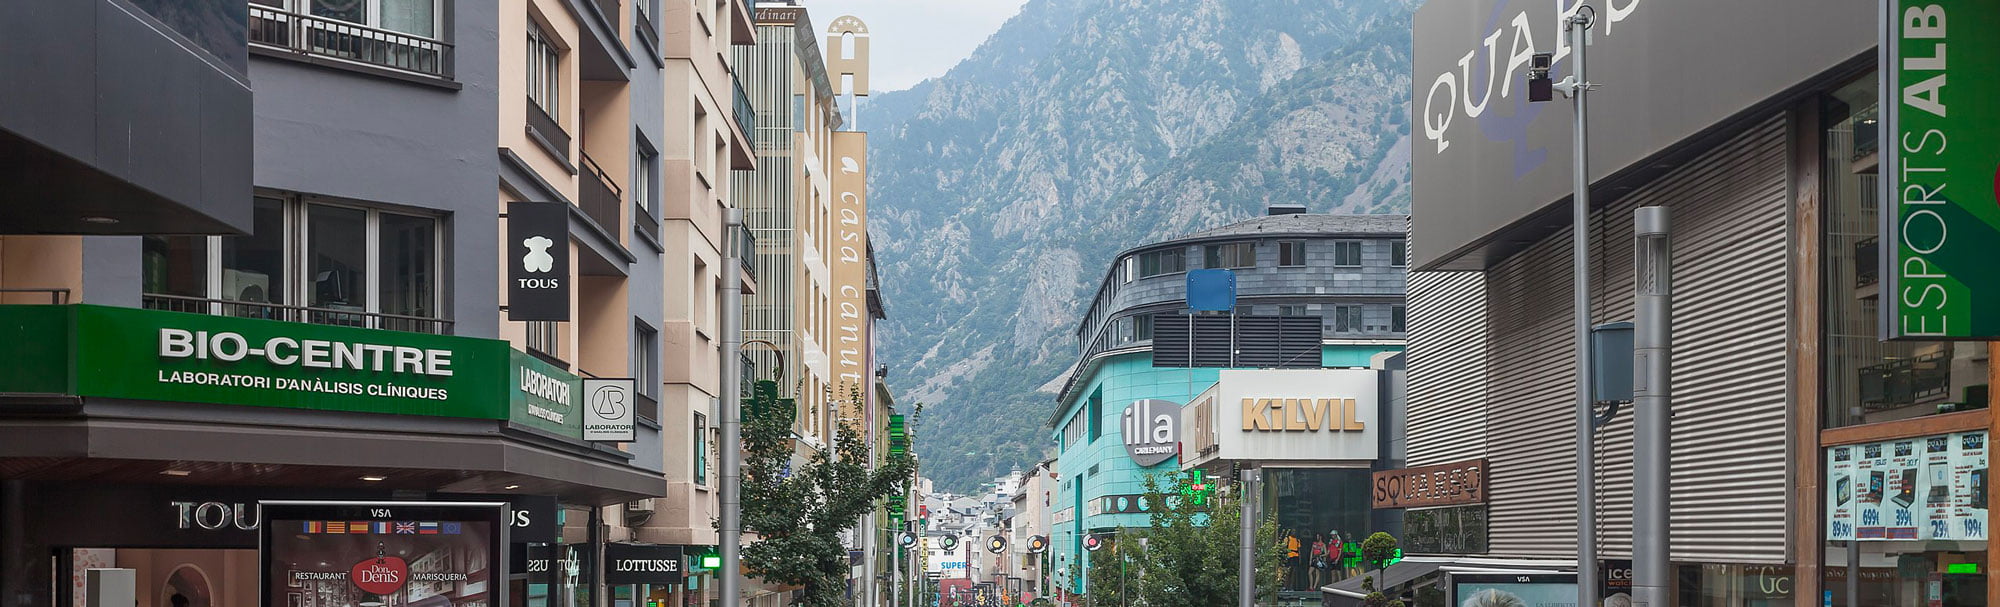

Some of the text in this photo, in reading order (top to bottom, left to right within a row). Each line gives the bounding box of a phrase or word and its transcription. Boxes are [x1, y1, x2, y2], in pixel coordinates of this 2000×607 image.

[841, 191, 859, 265] casa
[1903, 129, 1947, 337] ESPORTS
[518, 278, 559, 289] TOUS
[841, 285, 861, 383] canut
[159, 327, 453, 376] BIO-CENTRE
[158, 370, 449, 401] LABORATORI D'ANÀLISIS CLÍNIQUES
[520, 365, 570, 406] LABORATORI
[1125, 398, 1174, 445] illa
[1134, 446, 1173, 455] CARLEMANY
[171, 501, 260, 530] TOU
[371, 508, 392, 518] VSA
[295, 572, 346, 581] RESTAURANT
[371, 565, 389, 574] Don
[413, 572, 468, 582] MARISQUERIA
[616, 559, 678, 572] LOTTUSSE
[1760, 565, 1789, 594] Gc
